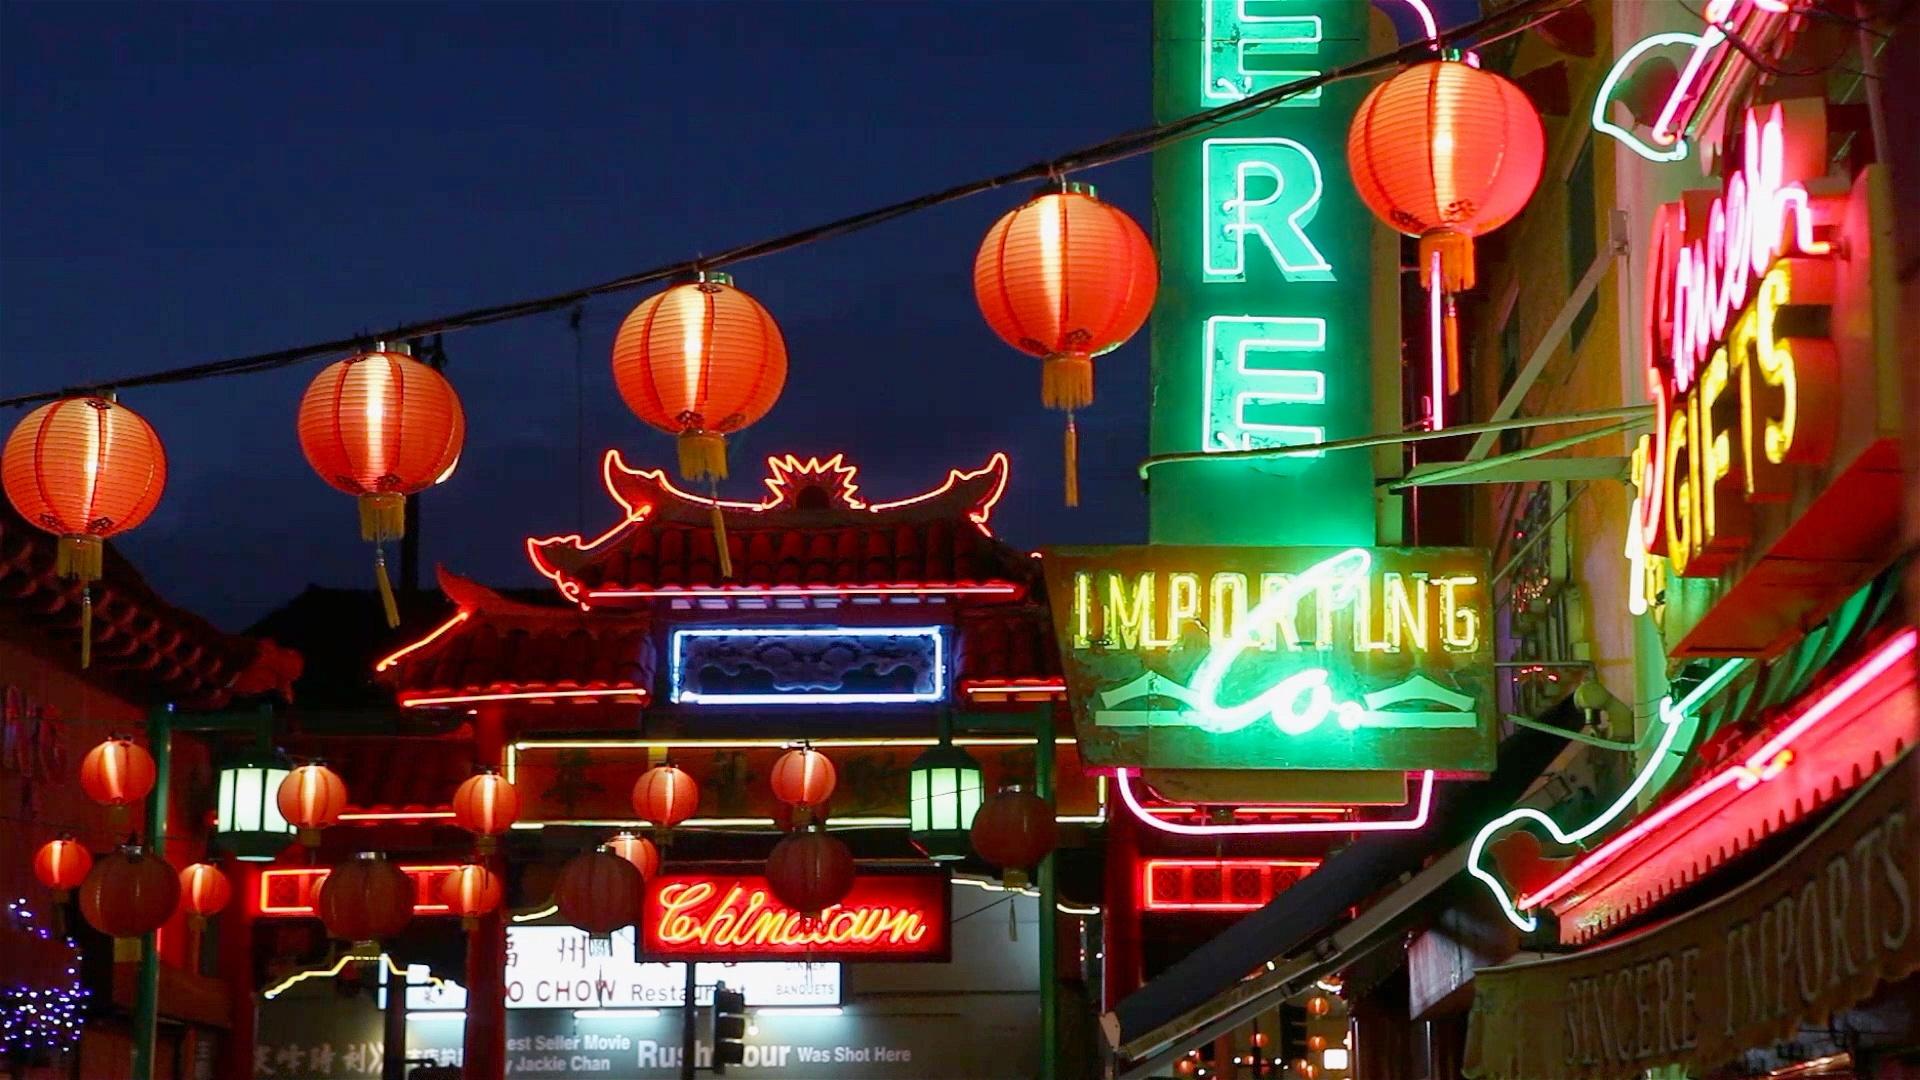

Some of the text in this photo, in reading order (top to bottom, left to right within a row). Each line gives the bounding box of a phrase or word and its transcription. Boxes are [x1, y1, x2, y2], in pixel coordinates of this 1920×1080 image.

[1665, 259, 1796, 576] GIFTS
[1072, 571, 1480, 653] IMPORTING
[659, 882, 926, 946] Chinatown
[1564, 812, 1912, 1064] SINCERE IMPORTS
[537, 980, 616, 1002] CHOW
[631, 984, 746, 1001] Restaurt
[506, 1034, 631, 1050] est Seller Movie
[516, 1056, 566, 1071] Jackie
[571, 1056, 610, 1071] Chan
[732, 1041, 790, 1067] our
[797, 1047, 830, 1062] Was
[834, 1047, 870, 1062] Shot
[874, 1047, 911, 1062] Here
